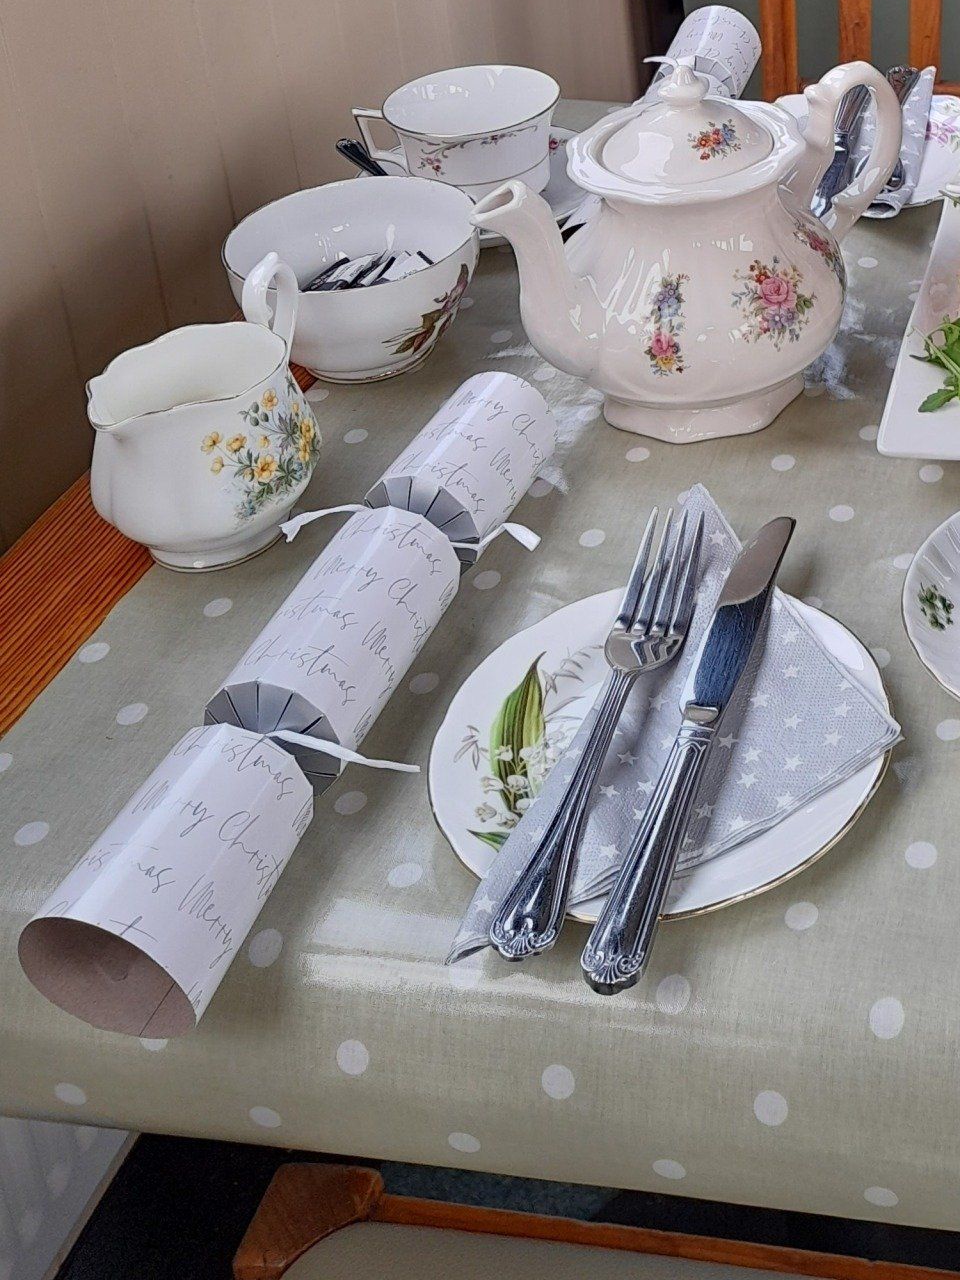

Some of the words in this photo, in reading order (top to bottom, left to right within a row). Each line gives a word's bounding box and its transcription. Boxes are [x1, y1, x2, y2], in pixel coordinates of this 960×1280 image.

[390, 450, 486, 514] Christmas
[313, 555, 384, 592] Merry
[340, 513, 442, 575] Christmas
[243, 634, 357, 705] Christmas
[173, 726, 294, 801] Chistmas
[177, 873, 234, 970] Merry
